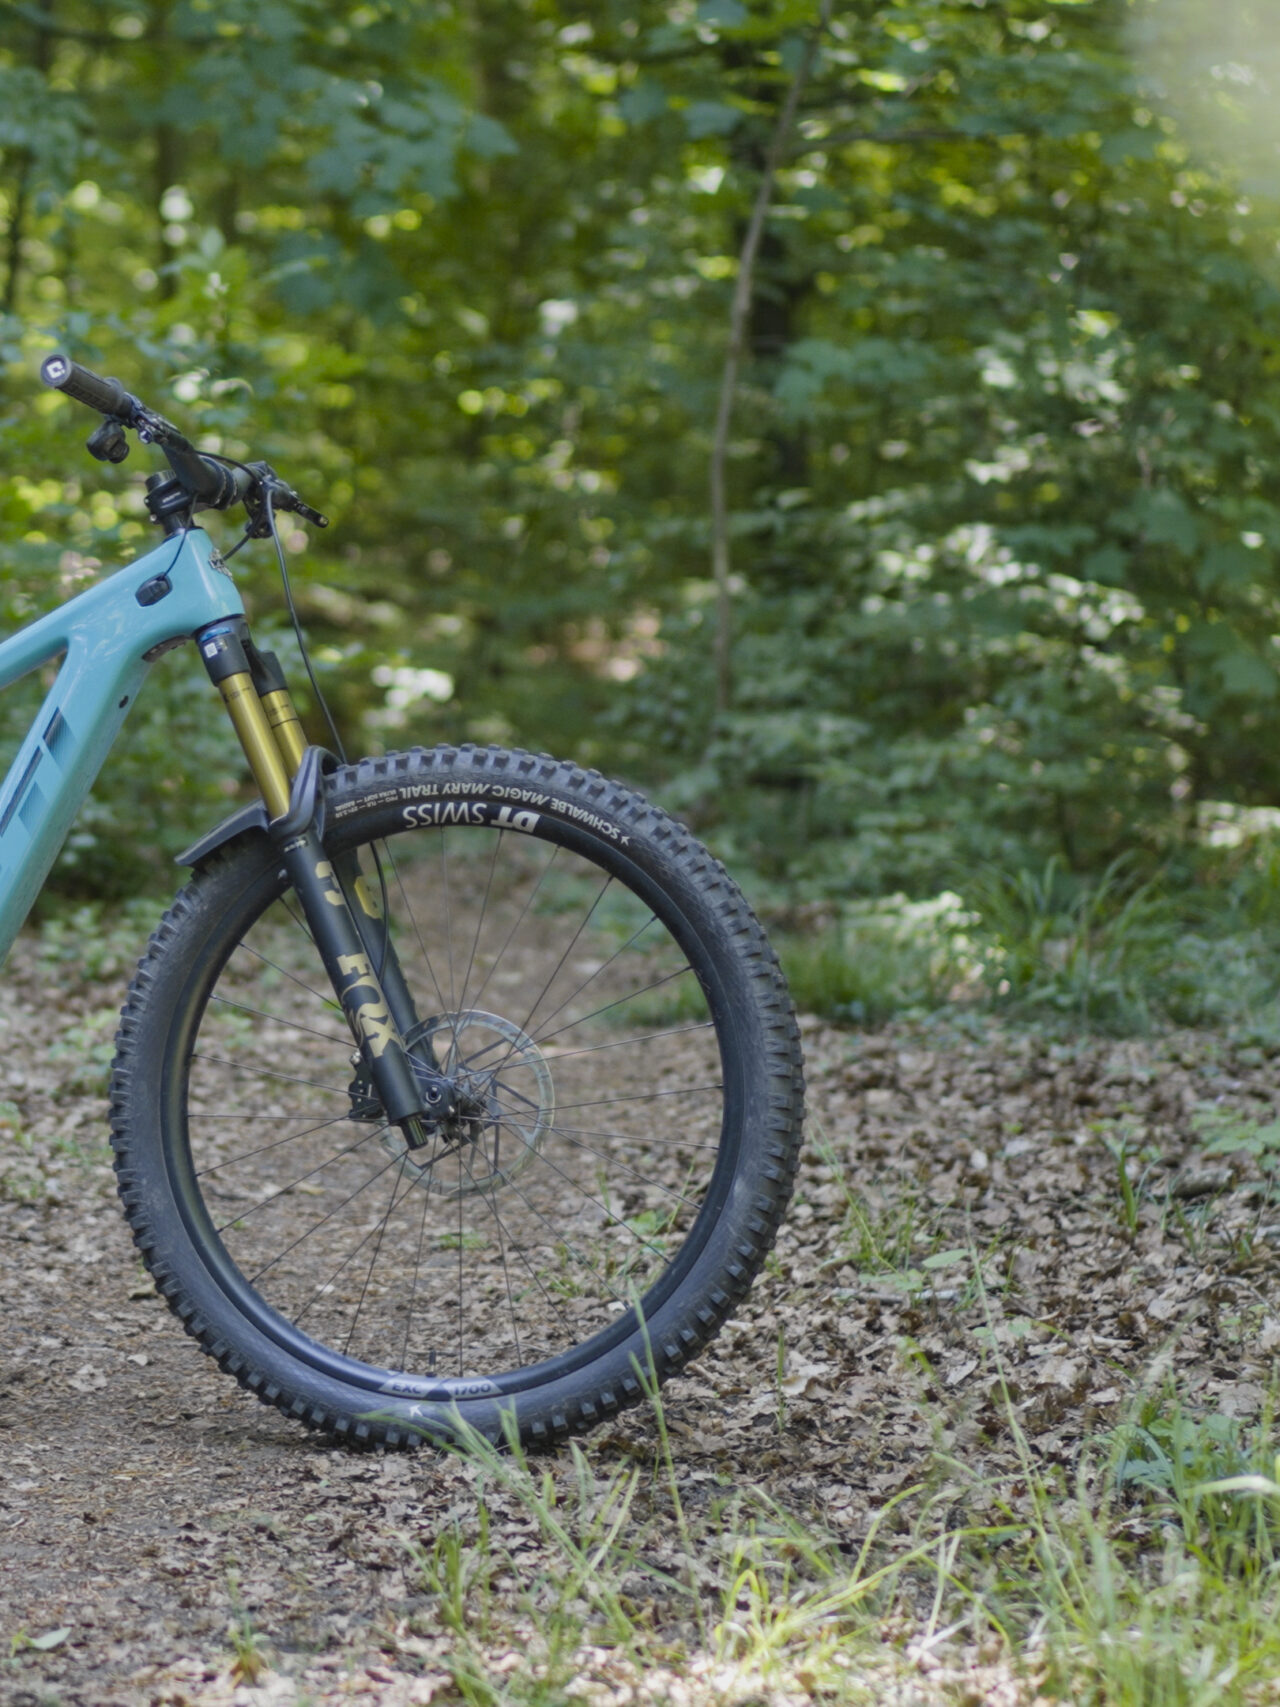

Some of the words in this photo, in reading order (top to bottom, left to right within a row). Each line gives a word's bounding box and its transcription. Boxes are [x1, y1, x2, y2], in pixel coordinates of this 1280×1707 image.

[399, 784, 438, 799] TRAIL
[443, 783, 490, 796] MARY
[492, 784, 550, 806] MAGIC
[402, 802, 487, 829] SWISS
[490, 805, 541, 834] DT
[551, 797, 620, 840] SCHWALBE
[336, 952, 404, 1058] FOX
[392, 1383, 422, 1394] EXC
[454, 1382, 491, 1395] 1700
